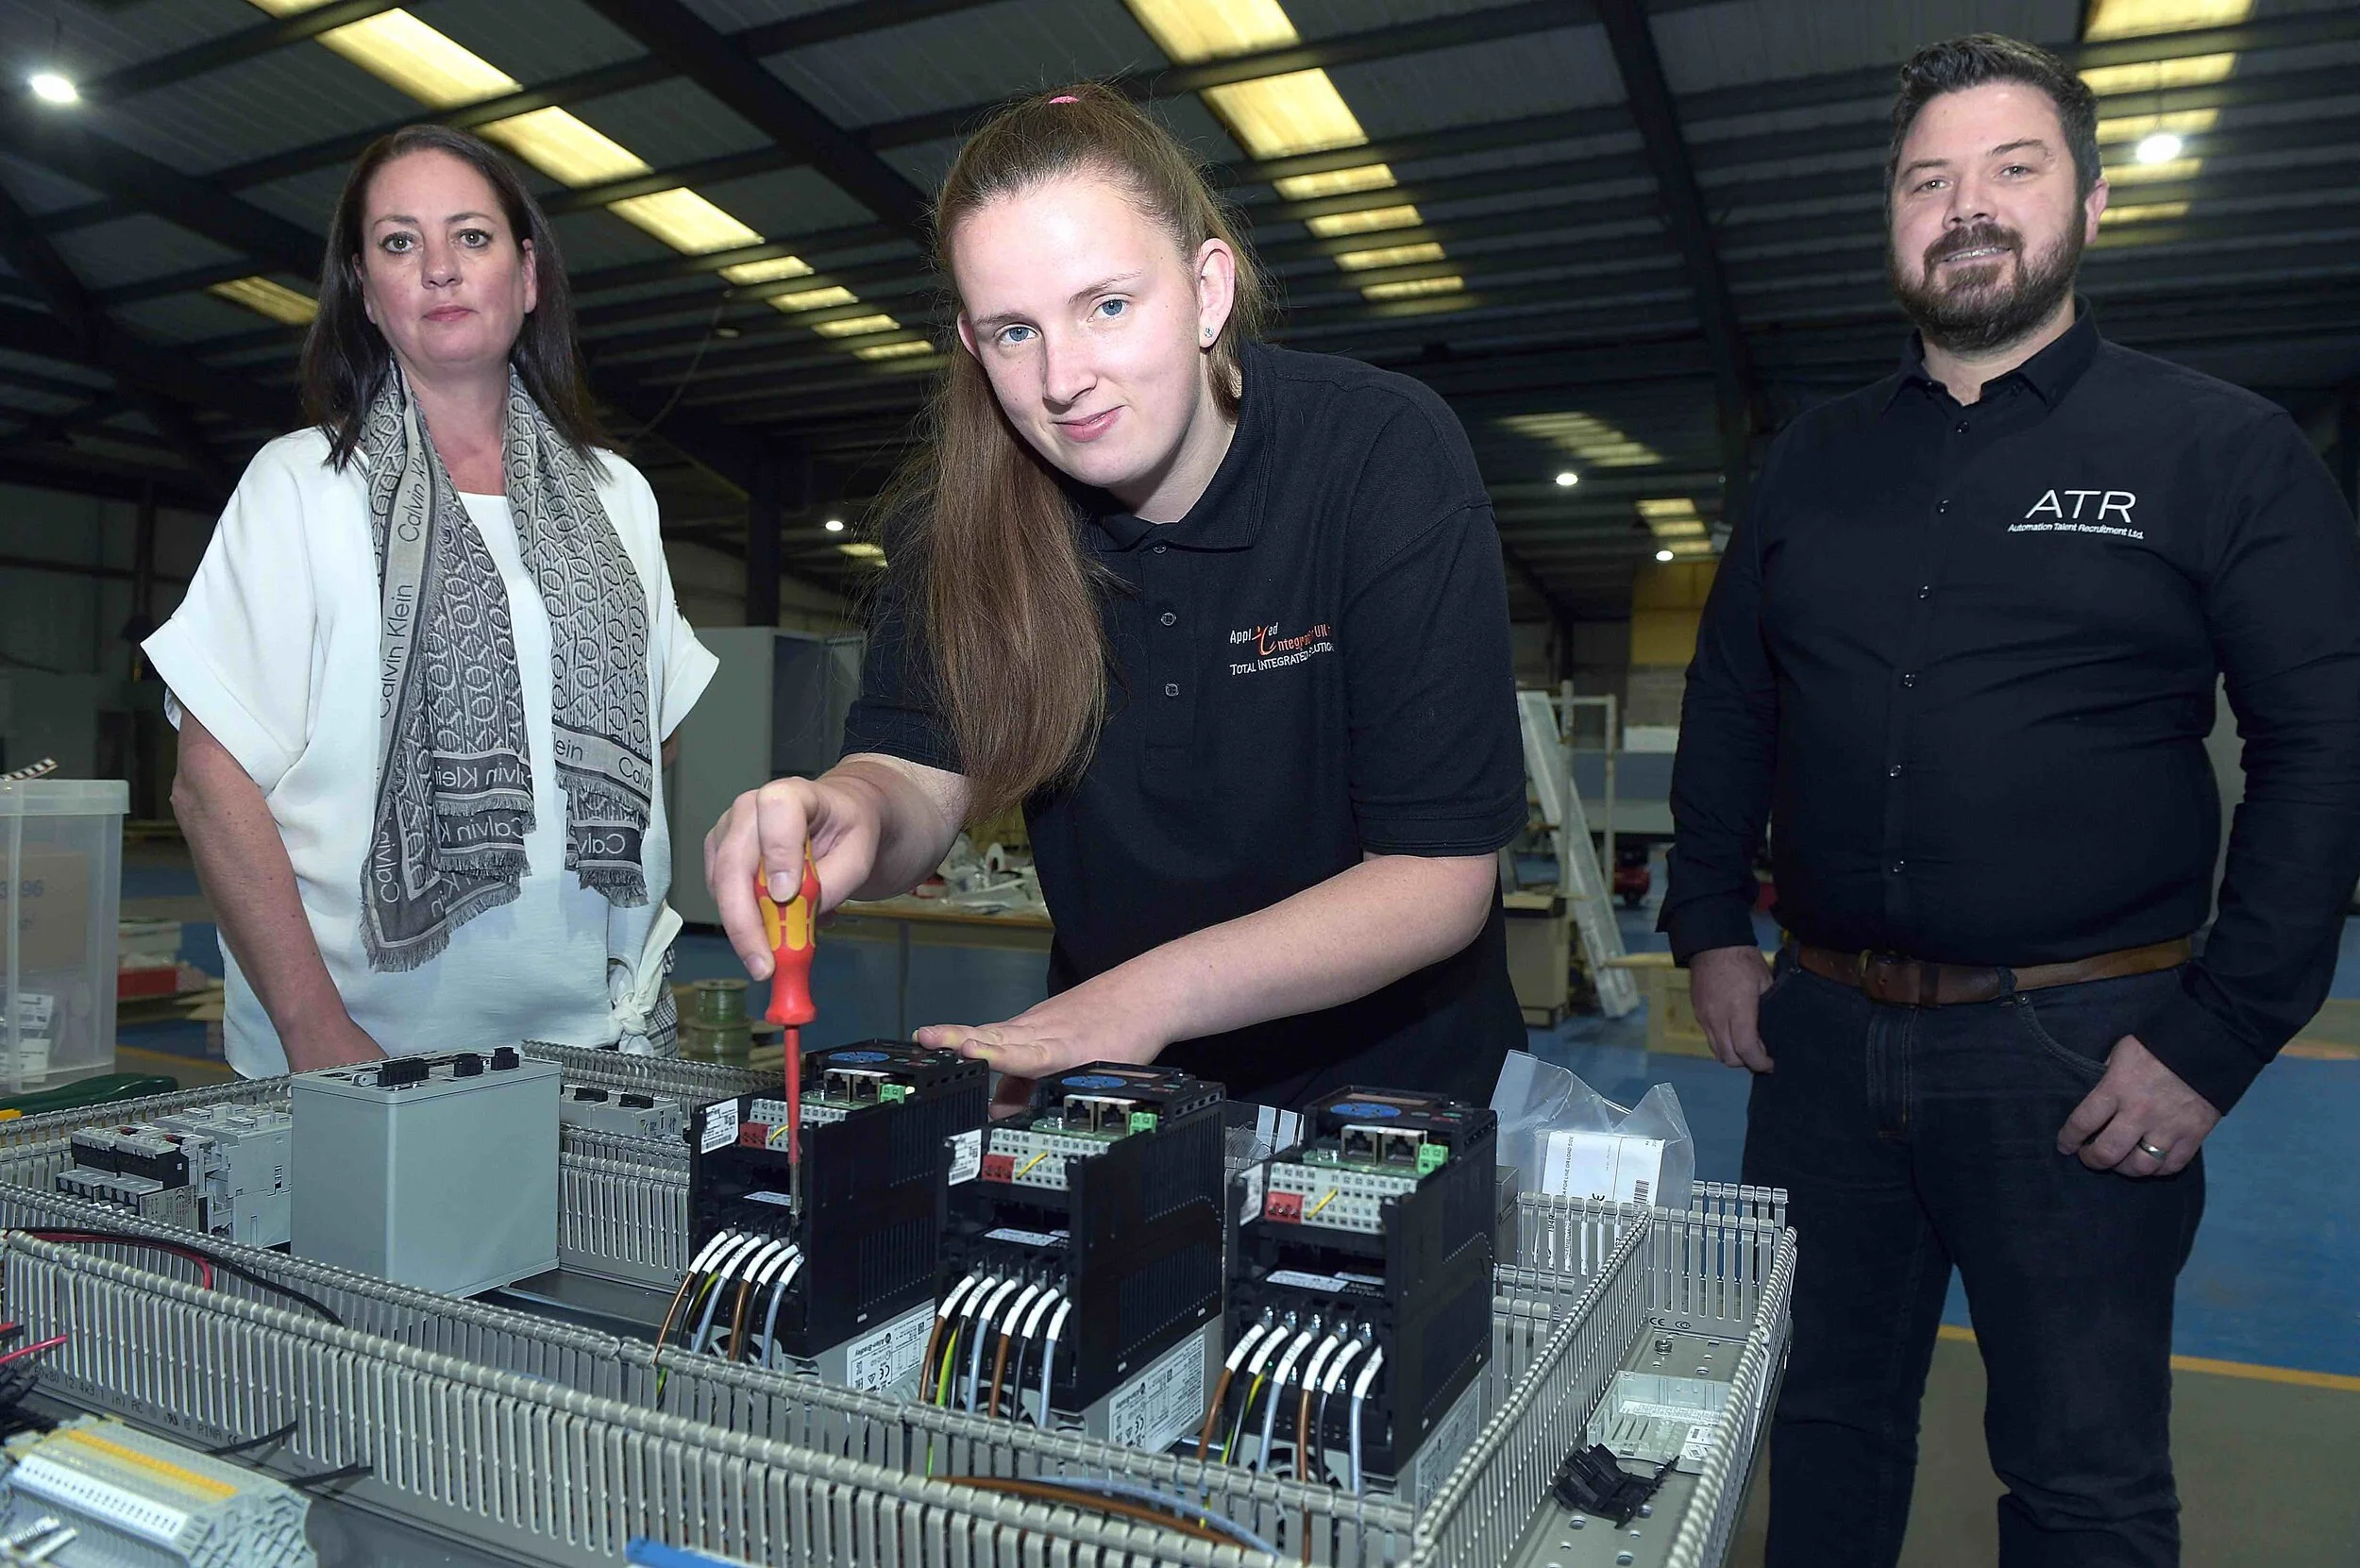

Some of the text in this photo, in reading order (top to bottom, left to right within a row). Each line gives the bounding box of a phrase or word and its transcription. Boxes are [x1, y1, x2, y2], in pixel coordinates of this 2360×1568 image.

[397, 483, 425, 542] Calvin
[2025, 489, 2136, 523] ATR
[2008, 523, 2052, 532] Automation
[2054, 522, 2077, 531] Talent
[2079, 524, 2127, 536] Recruitment
[387, 584, 413, 637] Klein
[1230, 663, 1256, 676] TOTAL
[1257, 650, 1308, 671] INTEGRATED
